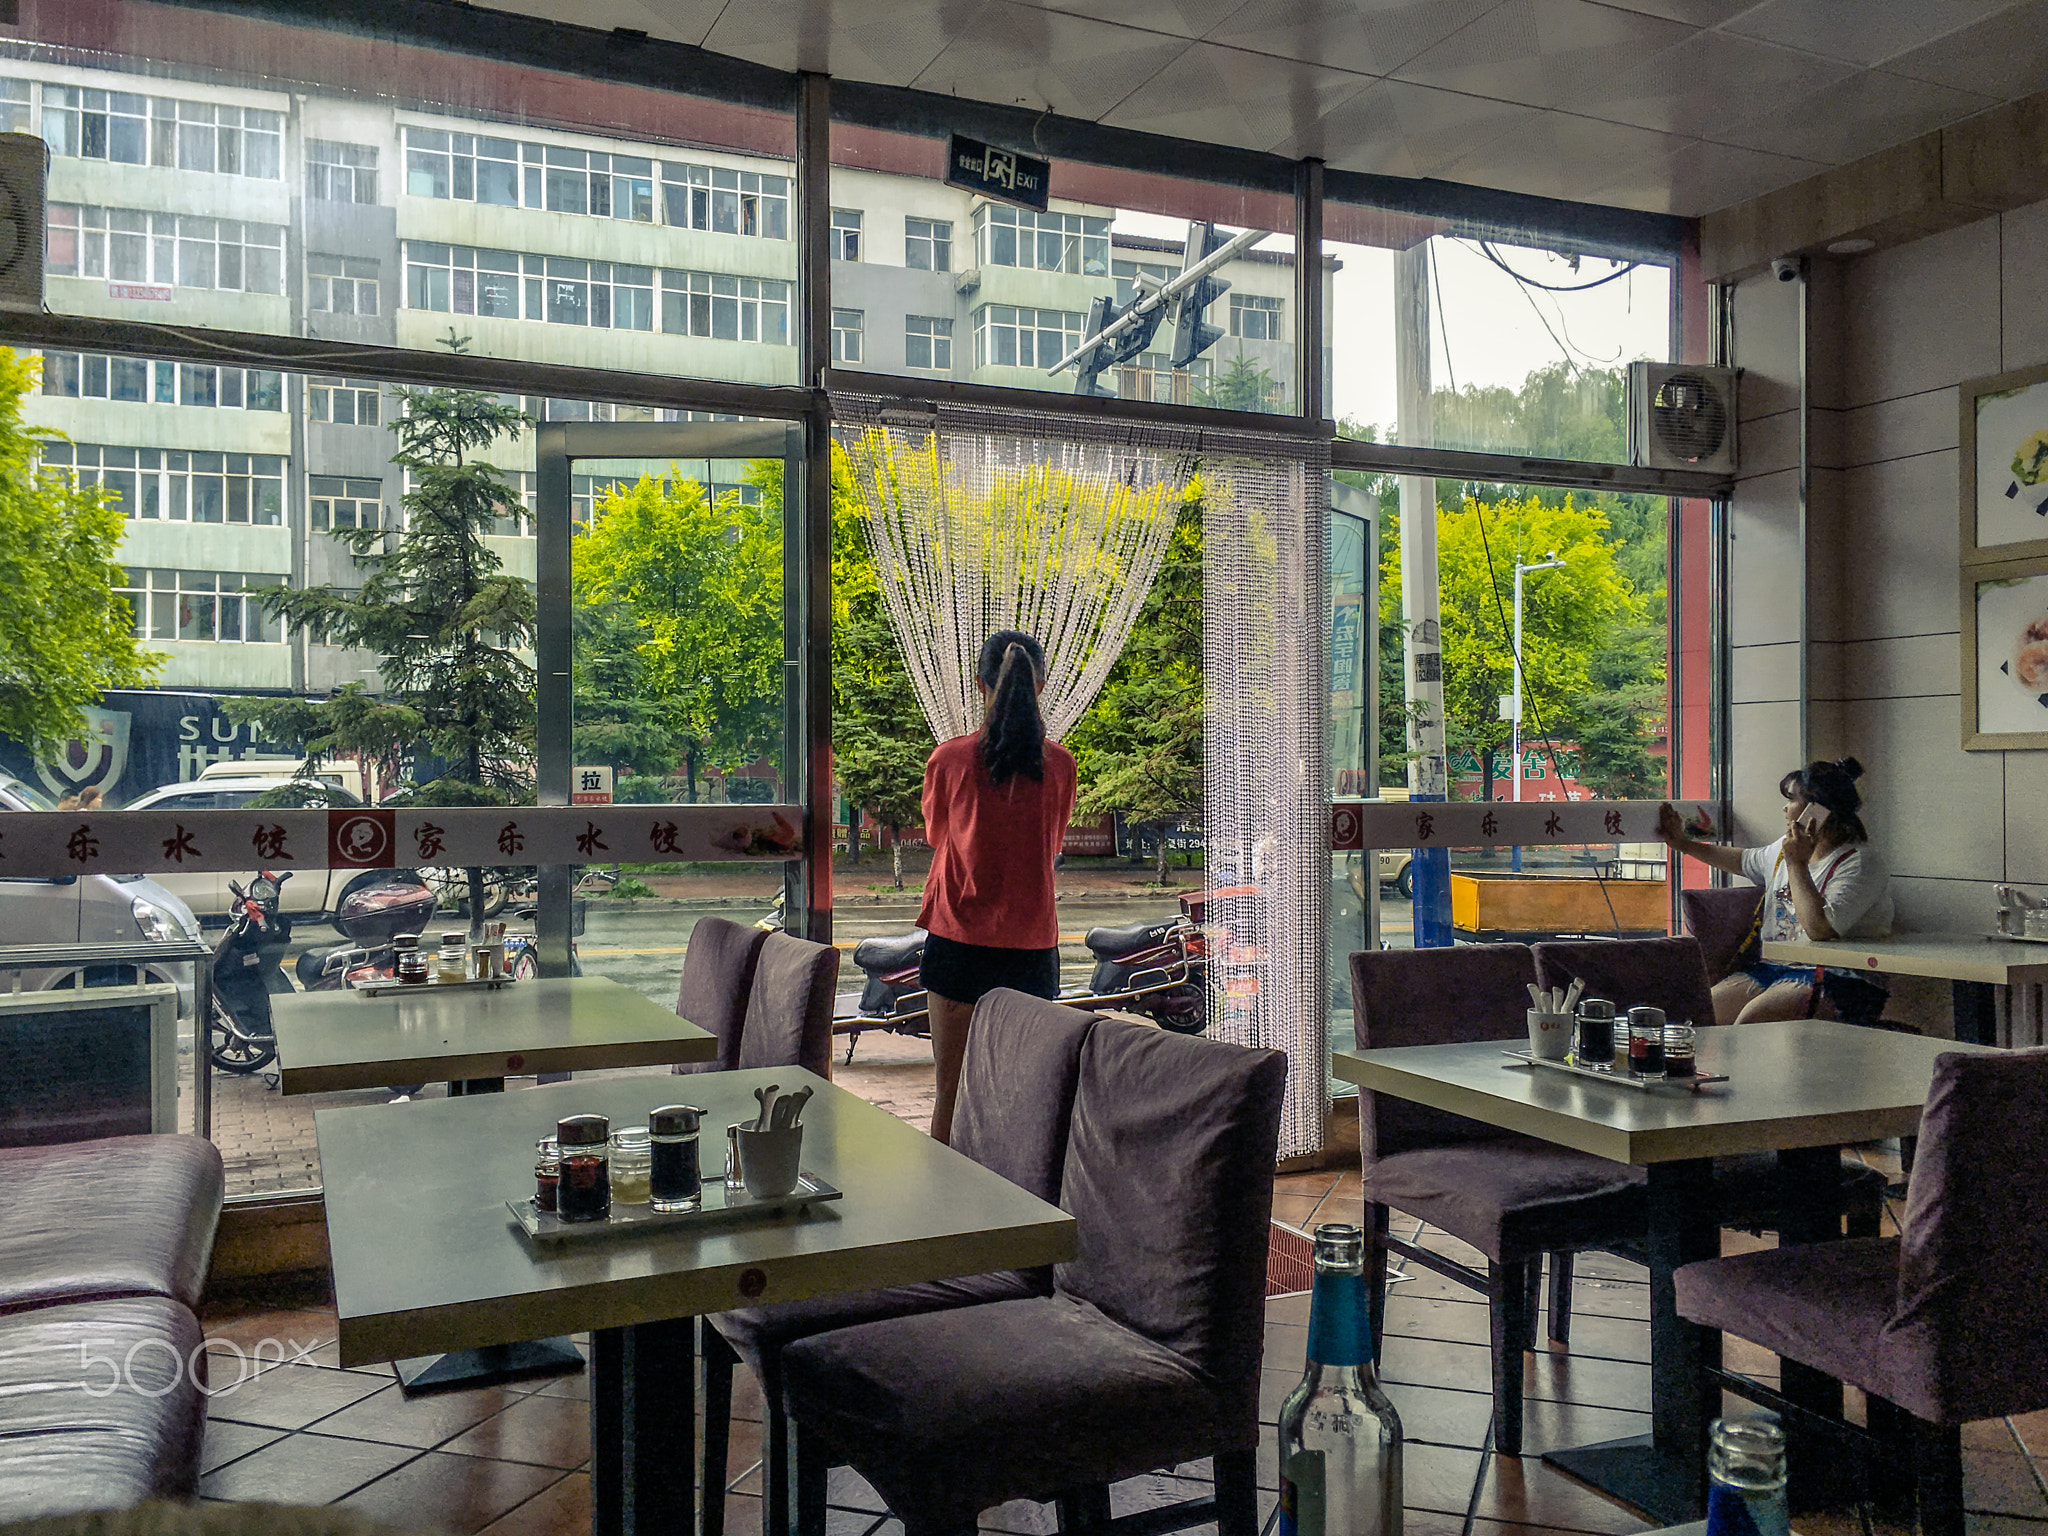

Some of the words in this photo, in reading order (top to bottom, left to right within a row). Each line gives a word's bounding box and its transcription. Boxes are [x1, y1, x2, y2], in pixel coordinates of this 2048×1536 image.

[1016, 171, 1040, 191] EXIT
[581, 771, 602, 791] 拉
[414, 821, 684, 859] 家乐水饺
[1415, 810, 1626, 841] 家乐水饺
[0, 824, 294, 863] 乐水饺
